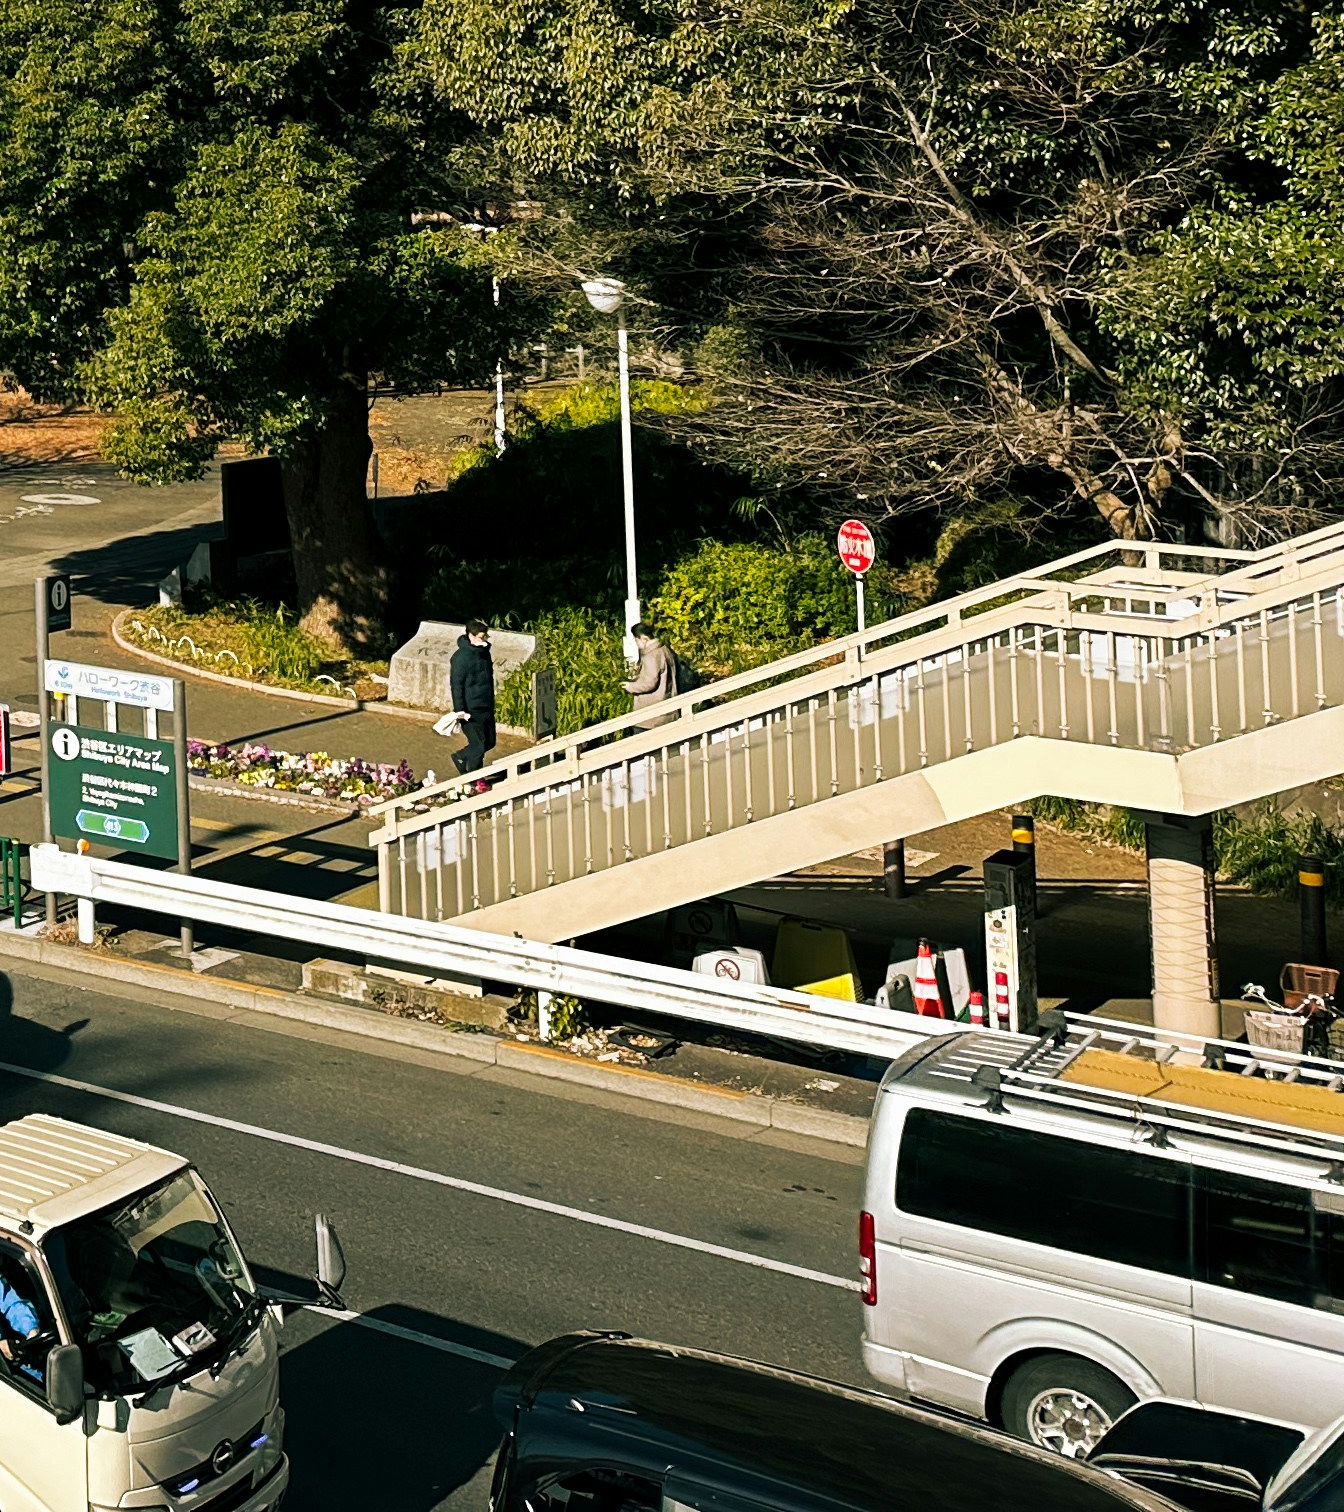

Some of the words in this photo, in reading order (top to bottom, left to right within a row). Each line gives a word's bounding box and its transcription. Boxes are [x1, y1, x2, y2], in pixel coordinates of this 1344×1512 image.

[78, 670, 161, 696] ハローワーク渋谷
